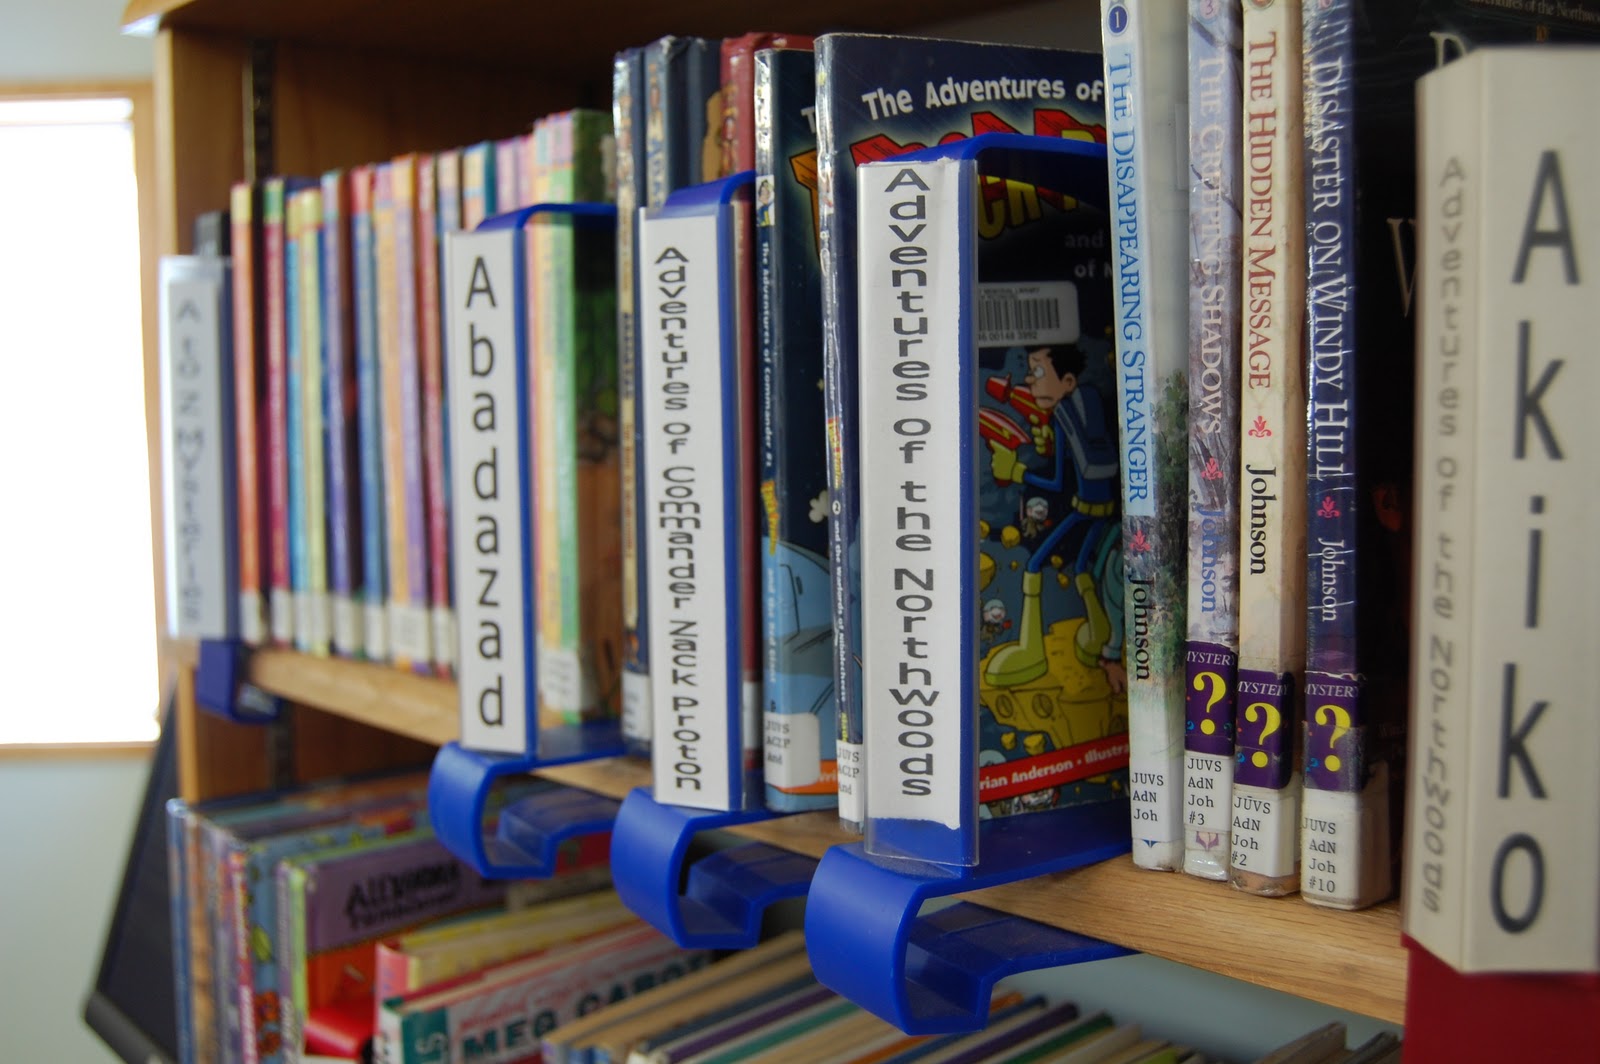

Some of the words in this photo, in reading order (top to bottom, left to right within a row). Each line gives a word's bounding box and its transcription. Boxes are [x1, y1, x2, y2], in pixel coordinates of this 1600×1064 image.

[862, 88, 914, 121] The
[926, 76, 1066, 109] Adventures
[1076, 80, 1104, 102] of
[1109, 53, 1134, 121] THE
[1199, 48, 1225, 116] THE
[1248, 31, 1277, 101] THE
[1309, 56, 1344, 212] DISASTER
[1200, 124, 1225, 276] CREEPING
[1248, 110, 1277, 237] HIDDEN
[1064, 229, 1104, 249] and
[1112, 127, 1142, 342] DISAPPEARING
[1313, 221, 1342, 266] ON
[884, 168, 931, 401] Adventures
[1074, 259, 1096, 278] of
[1438, 156, 1466, 437] Adventures
[654, 247, 690, 411] Adventures
[1248, 247, 1276, 390] MESSAGE
[1312, 275, 1347, 390] WINDY
[1200, 284, 1225, 434] SHADOWS
[663, 422, 691, 454] of
[893, 418, 931, 464] of
[1122, 350, 1148, 502] STRANGER
[1314, 400, 1348, 481] HILL
[465, 256, 504, 728] Abadazad
[895, 480, 932, 552] the
[1436, 455, 1458, 512] of
[659, 466, 701, 608] Commander
[1246, 464, 1278, 575] Johnson
[1489, 149, 1581, 936] Akiko
[1195, 504, 1225, 613] Johnson
[1318, 538, 1346, 622] Johnson
[669, 620, 698, 687] Zack
[1128, 575, 1155, 681] Johnson
[888, 568, 940, 796] Northwoods
[979, 776, 1008, 791] rian
[1011, 759, 1074, 784] Anderson
[1131, 772, 1164, 786] JUVS
[1132, 790, 1157, 803] AdN
[1187, 758, 1222, 773] JUVS
[1187, 777, 1214, 790] AdN
[1133, 808, 1158, 823] Joh
[1187, 795, 1215, 808] Joh
[1188, 811, 1205, 826] #3
[1233, 818, 1261, 832] AdN
[1234, 796, 1271, 815] JUVS
[1302, 817, 1337, 834] JUVS
[1231, 853, 1248, 867] #2
[1232, 836, 1259, 851] Joh
[1308, 838, 1337, 855] AdN
[1308, 857, 1337, 874] Joh
[1309, 877, 1337, 894] #10
